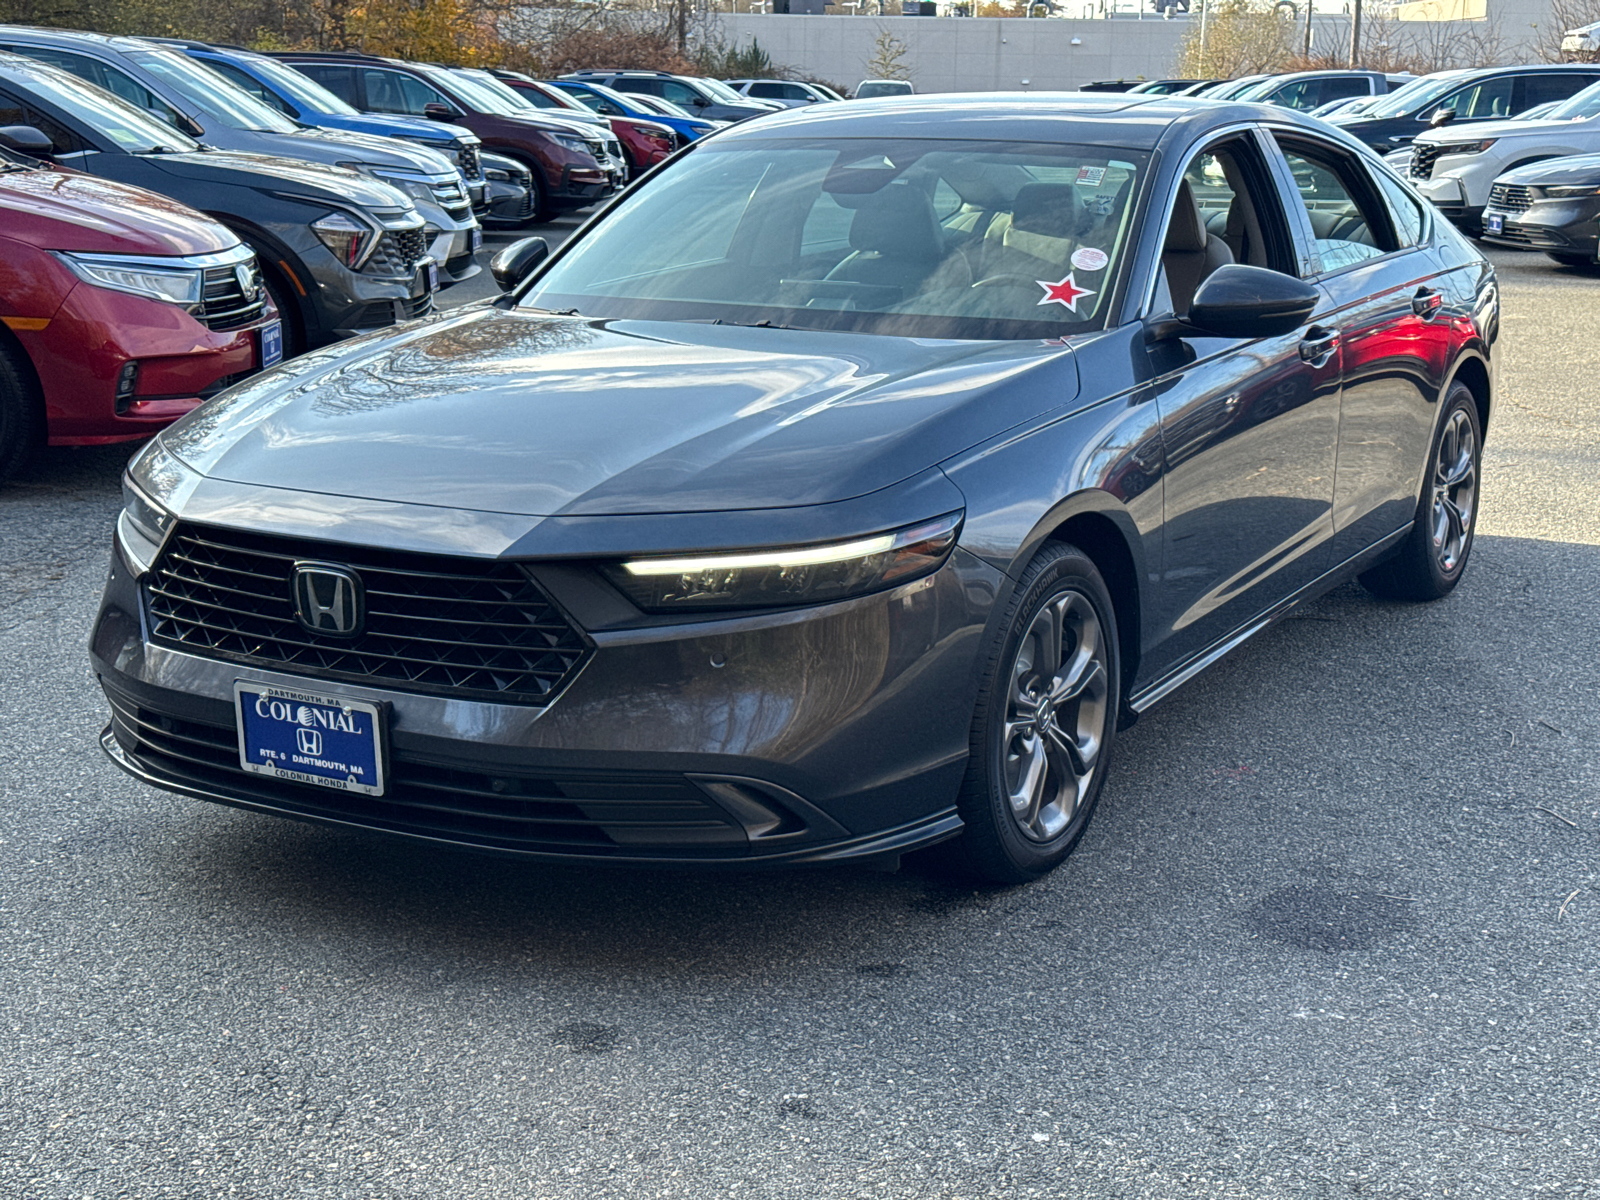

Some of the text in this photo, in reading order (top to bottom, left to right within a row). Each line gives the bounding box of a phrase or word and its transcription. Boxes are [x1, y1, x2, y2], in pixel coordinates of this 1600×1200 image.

[1014, 567, 1060, 636] BLACKHAWK
[327, 698, 341, 707] MA
[255, 698, 362, 735] COLONIAL
[259, 748, 286, 761] RTE. 6
[292, 754, 364, 775] DARTMOUTH, MA
[274, 769, 348, 790] COLONIAL HONDA
